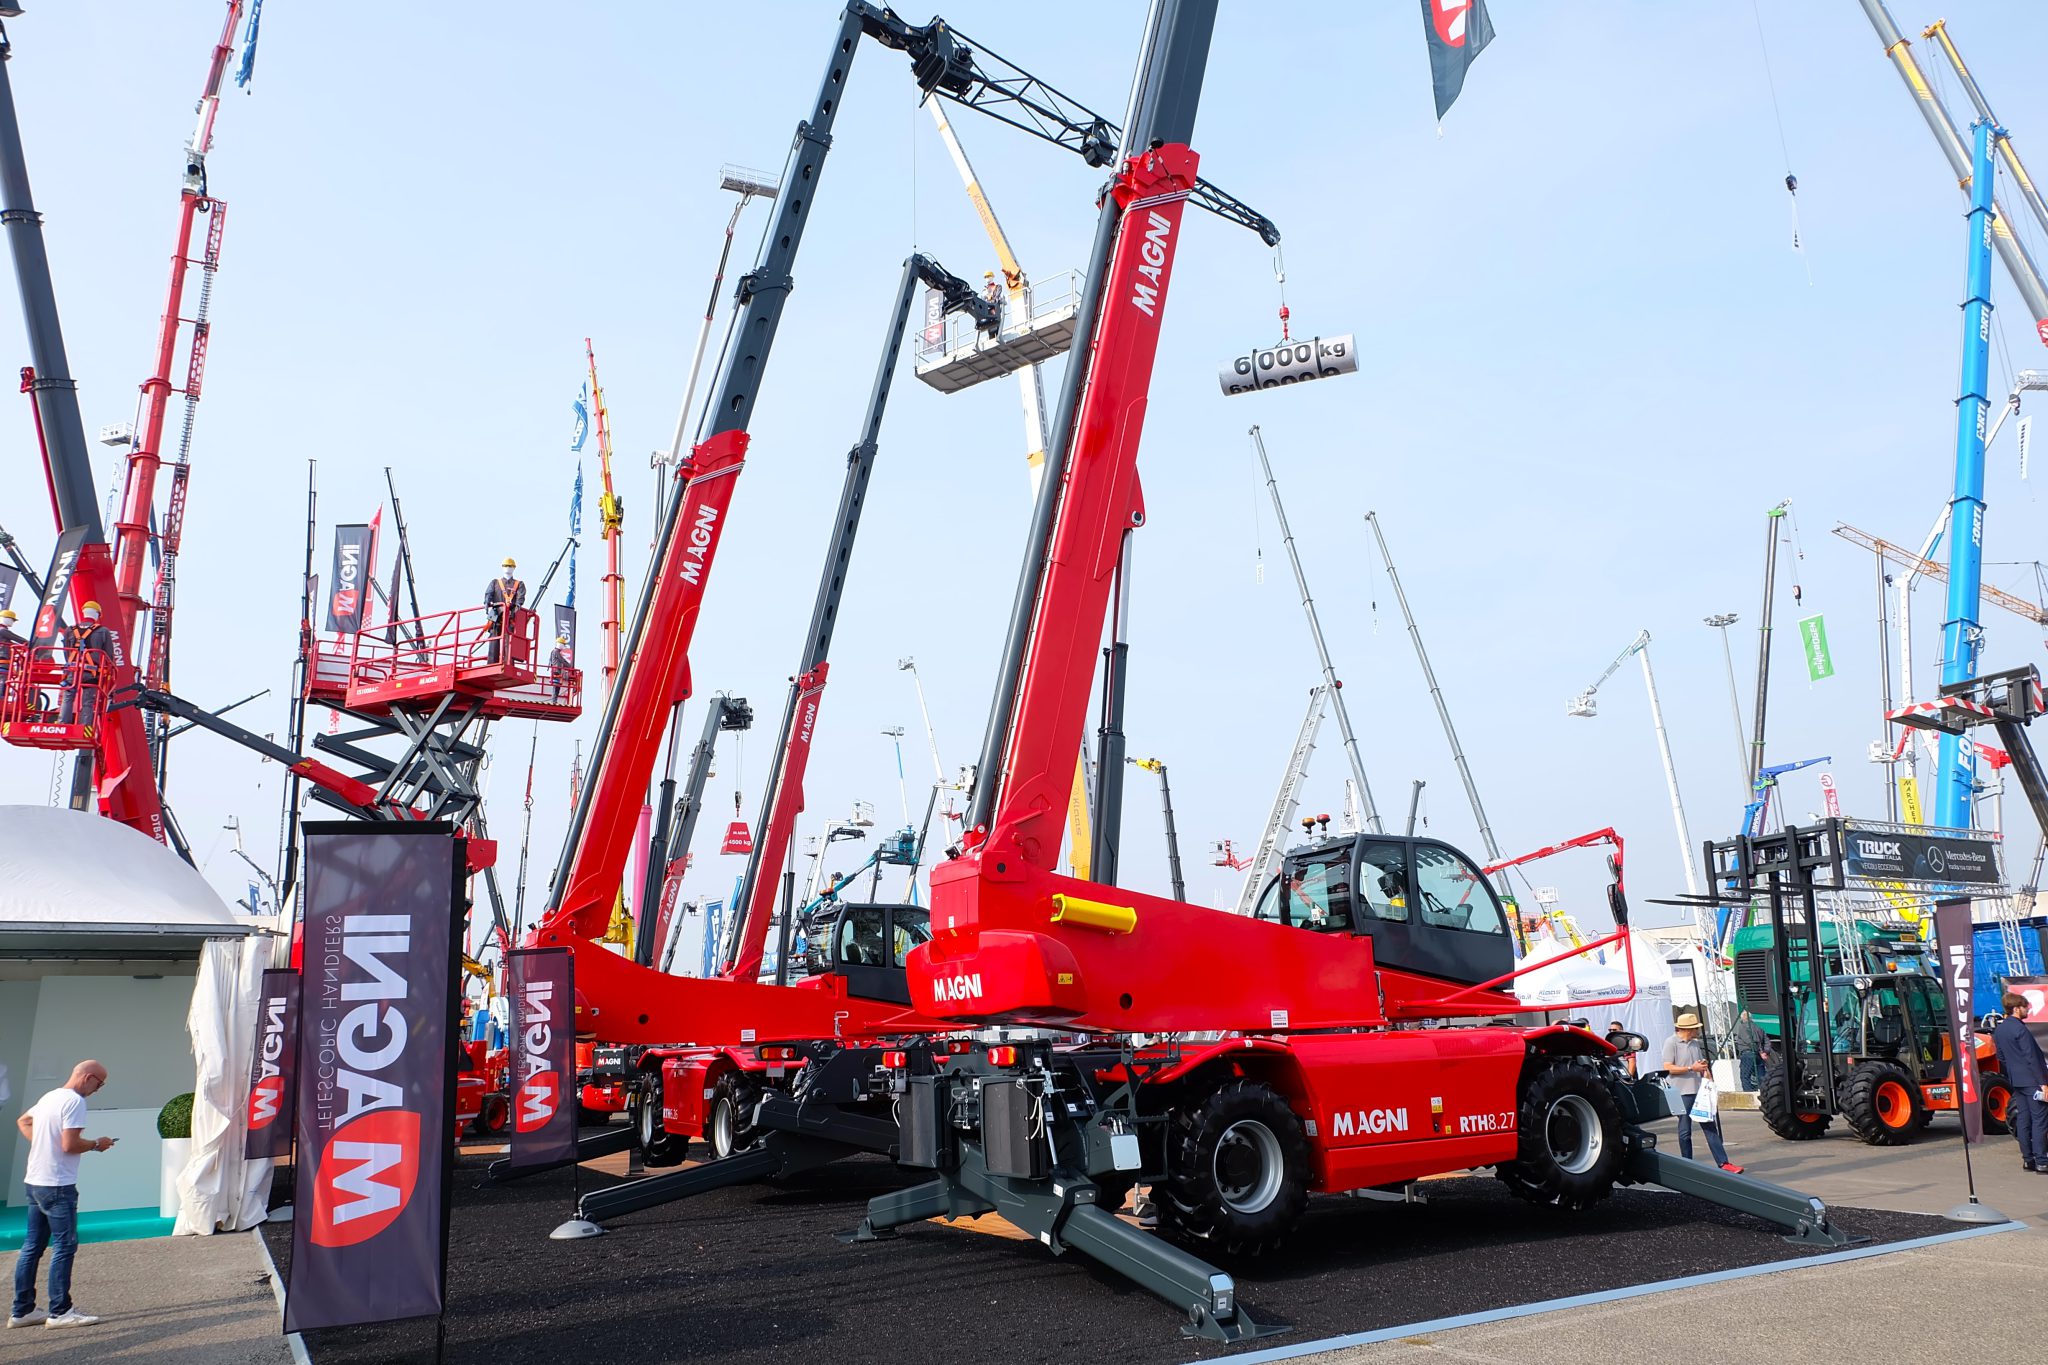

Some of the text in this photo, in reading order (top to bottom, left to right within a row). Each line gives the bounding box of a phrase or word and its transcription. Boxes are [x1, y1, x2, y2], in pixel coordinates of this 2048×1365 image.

[1131, 210, 1172, 318] MAGNI
[1319, 342, 1346, 358] kg
[679, 503, 719, 586] MAGNI
[109, 629, 125, 667] MAGNI
[30, 725, 67, 735] MAGNI
[800, 702, 816, 743] MAGNI
[1856, 839, 1901, 858] TRUCK
[662, 881, 678, 924] MAGNI
[933, 973, 983, 1002] MAGNI
[598, 1057, 621, 1066] MAGNI
[1333, 1107, 1409, 1137] MAGNI
[1459, 1112, 1516, 1133] RTH8.27
